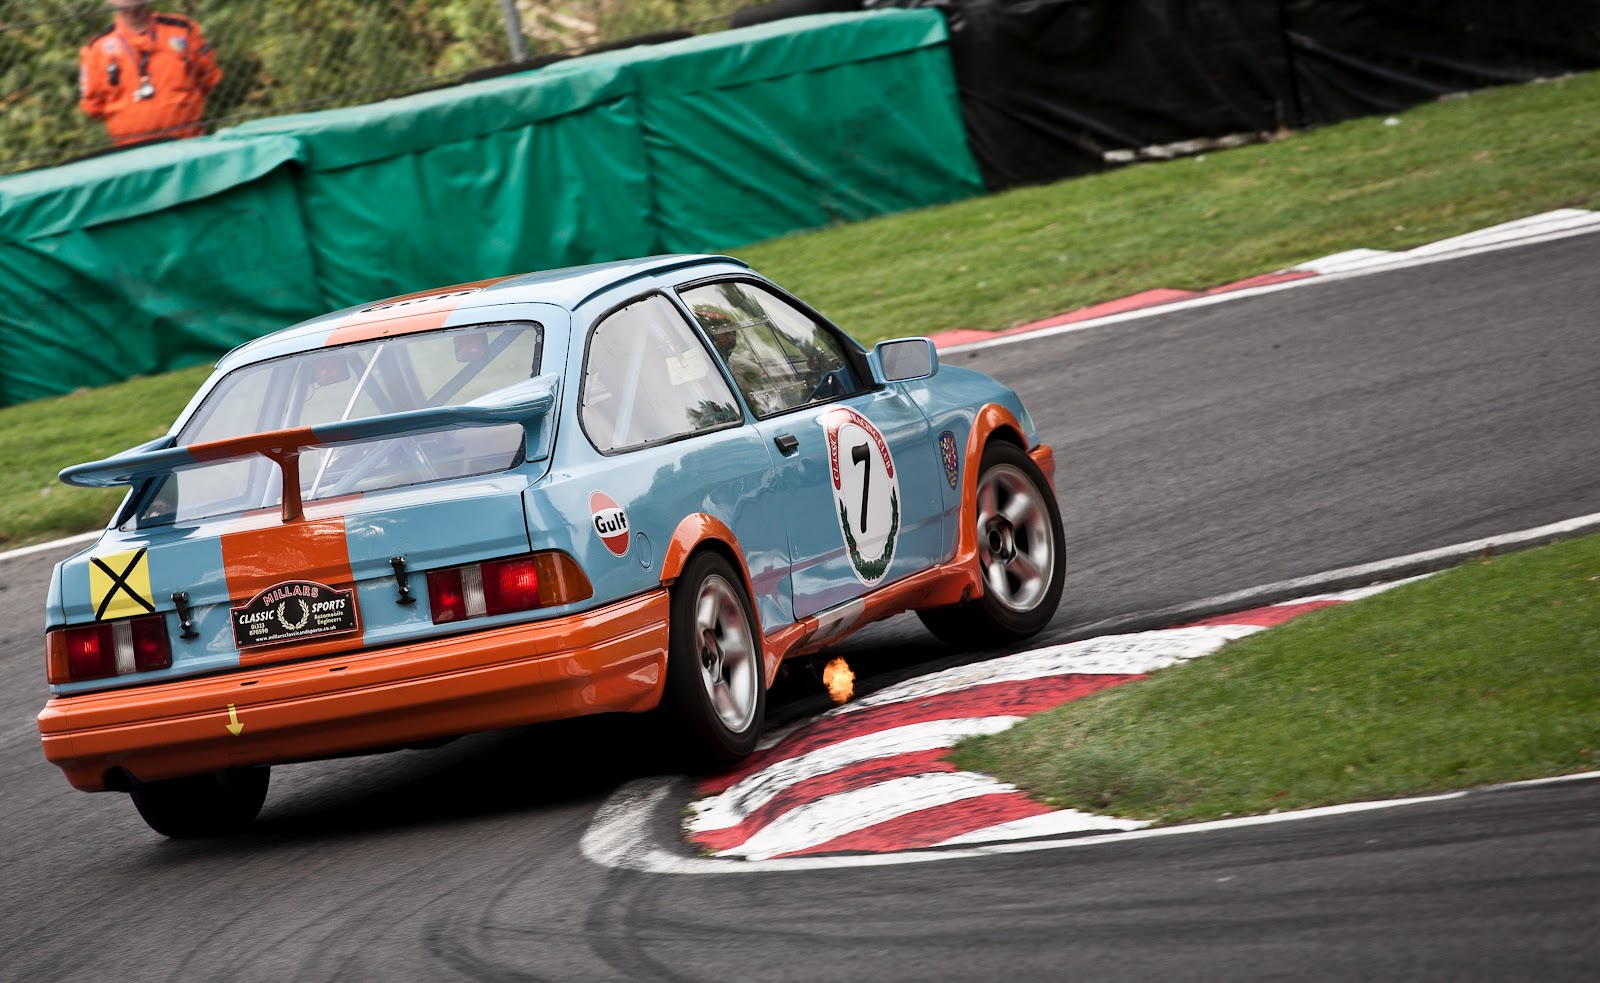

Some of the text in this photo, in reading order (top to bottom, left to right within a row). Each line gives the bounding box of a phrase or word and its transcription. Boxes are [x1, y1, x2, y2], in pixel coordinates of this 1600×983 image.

[877, 439, 891, 469] CLUB
[851, 441, 871, 534] 7
[594, 511, 627, 534] Gulf
[262, 585, 319, 606] MILLARS
[311, 598, 346, 613] SPORTS
[239, 609, 275, 625] CLASSIC
[314, 610, 344, 620] Automobile
[316, 617, 342, 626] Engineers
